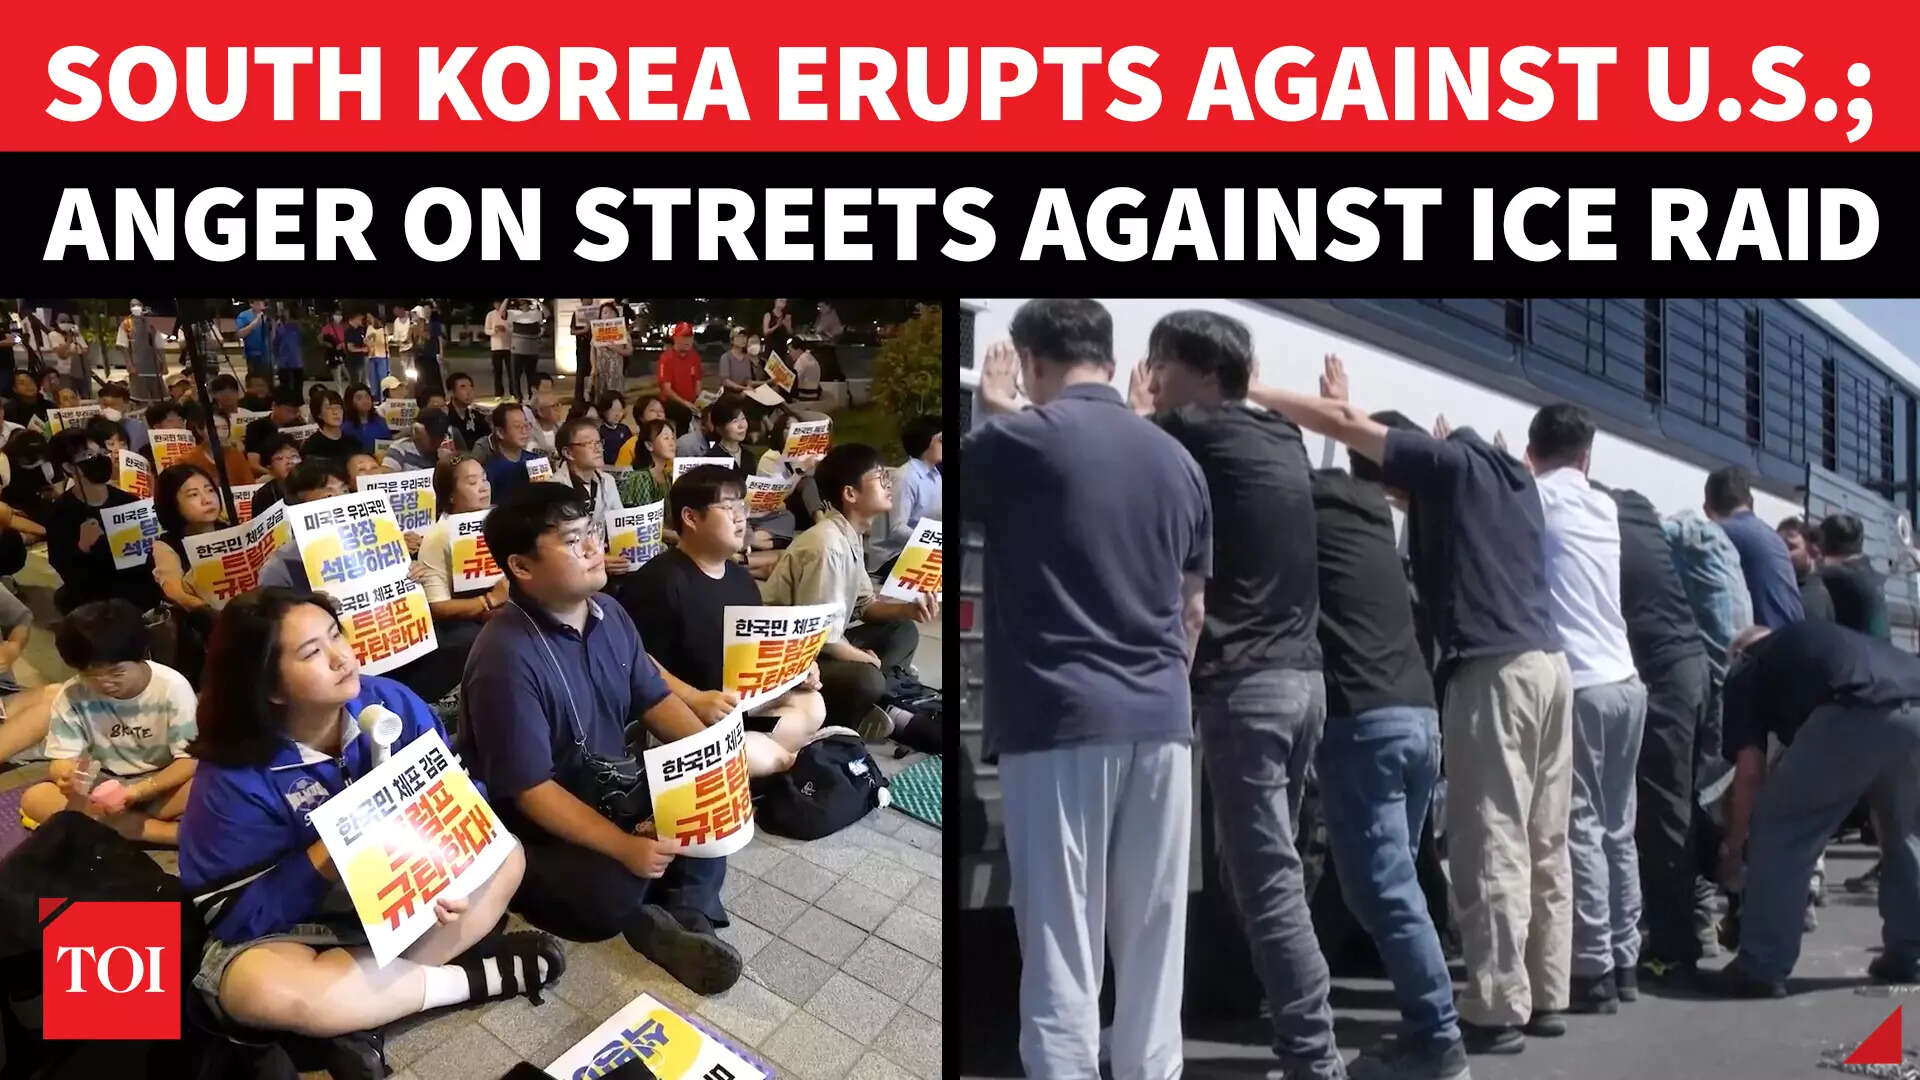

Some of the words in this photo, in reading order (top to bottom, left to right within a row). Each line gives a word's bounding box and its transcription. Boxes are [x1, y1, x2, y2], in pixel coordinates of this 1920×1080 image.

[389, 490, 419, 513] 당장
[400, 476, 431, 492] 우리국민
[112, 507, 149, 525] 미국은
[304, 507, 346, 531] 미국은
[347, 499, 388, 521] 우리국민
[615, 513, 645, 528] 미국은
[196, 536, 243, 559] 한국민
[245, 523, 265, 546] 체포
[266, 508, 285, 530] 감금
[338, 518, 378, 549] 당장
[637, 522, 661, 544] 당장
[221, 529, 277, 577] 트럼프
[320, 539, 406, 584] 석방하라!
[373, 585, 395, 604] 체포
[351, 596, 413, 640] 트럼프
[735, 618, 788, 638] 한국민
[792, 616, 822, 635] 체포
[351, 617, 429, 668] 규탄한다!
[756, 630, 827, 669] 트럼프
[662, 740, 723, 783] 한국민
[724, 722, 744, 755] 체포
[336, 785, 398, 847] 한국민
[392, 765, 426, 802] 체포
[419, 746, 449, 780] 감금
[377, 804, 498, 932] 규탄한다!
